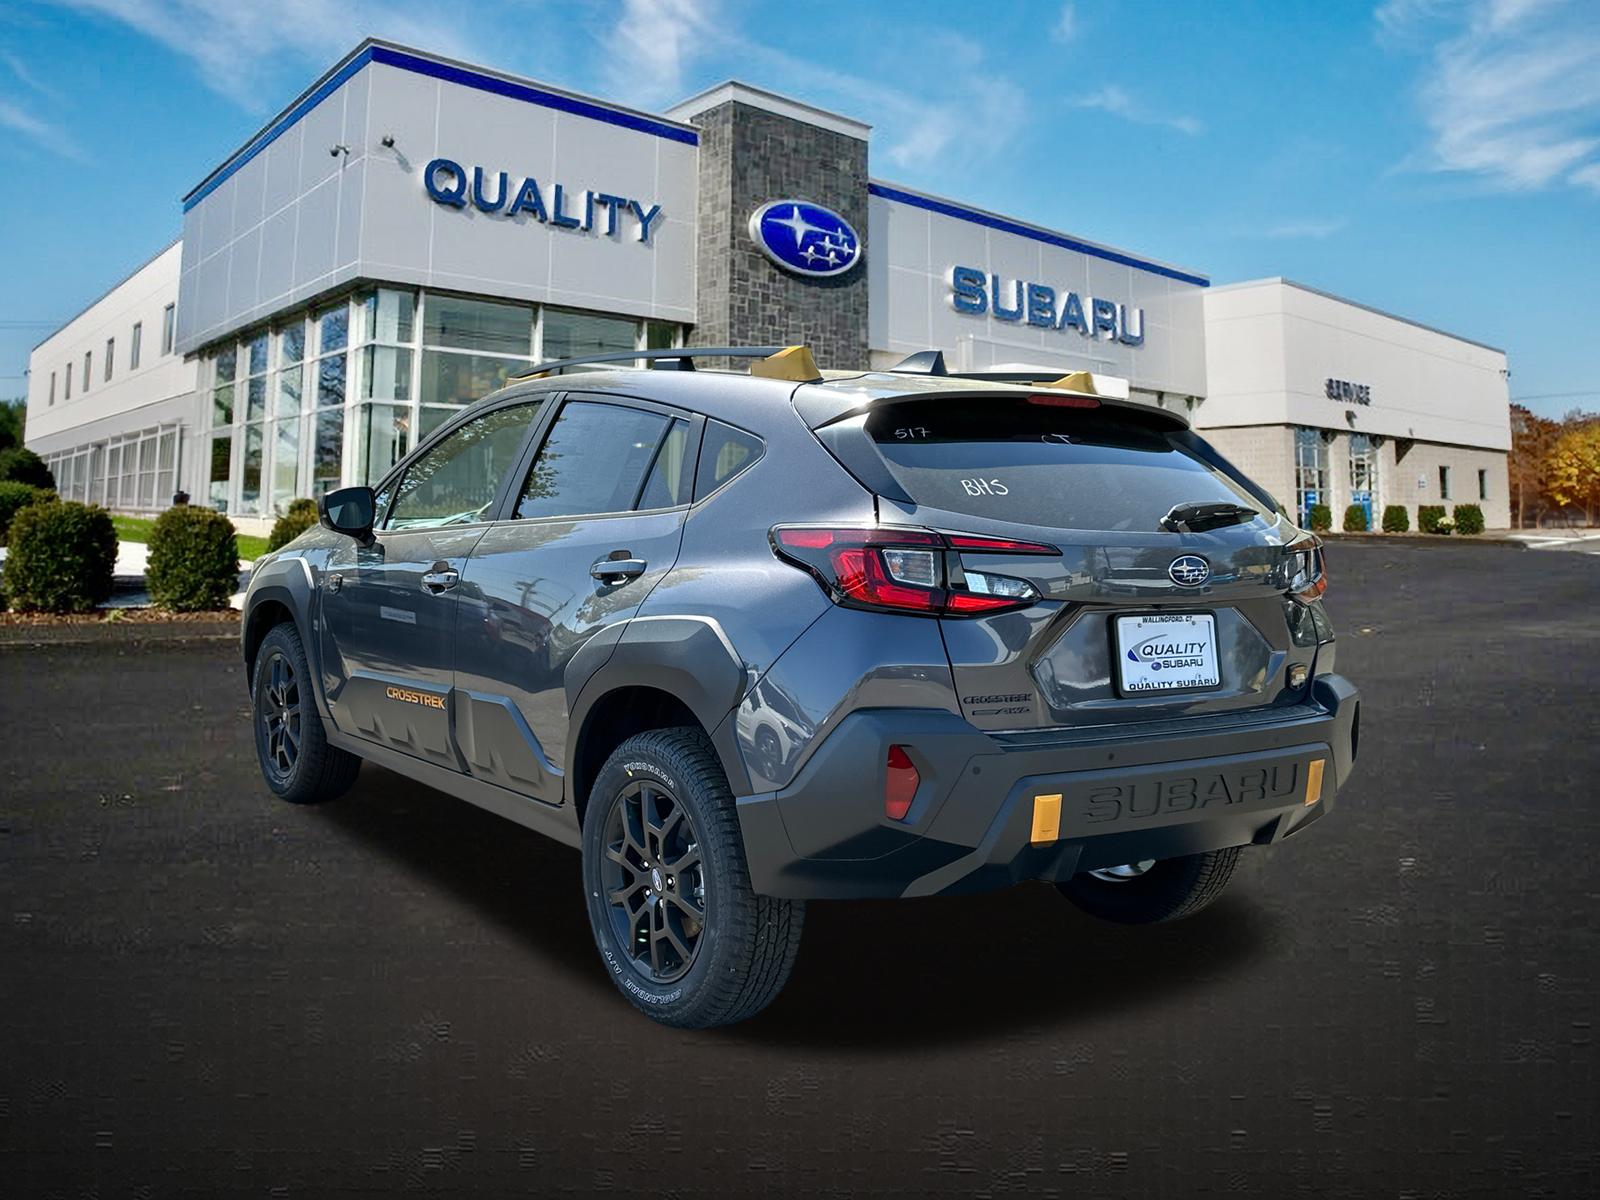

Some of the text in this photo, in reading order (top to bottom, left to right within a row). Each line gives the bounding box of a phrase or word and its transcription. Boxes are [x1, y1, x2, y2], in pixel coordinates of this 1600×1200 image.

[424, 158, 662, 243] QUALITY
[949, 265, 1146, 347] SUBARU
[1142, 642, 1207, 656] QUALITY
[1162, 658, 1204, 669] SUBARU
[1129, 678, 1217, 691] QUALITY SUBARU
[386, 686, 446, 709] CROSSTREK
[963, 693, 1032, 704] CROSSTREK
[1085, 763, 1298, 824] SUBARU
